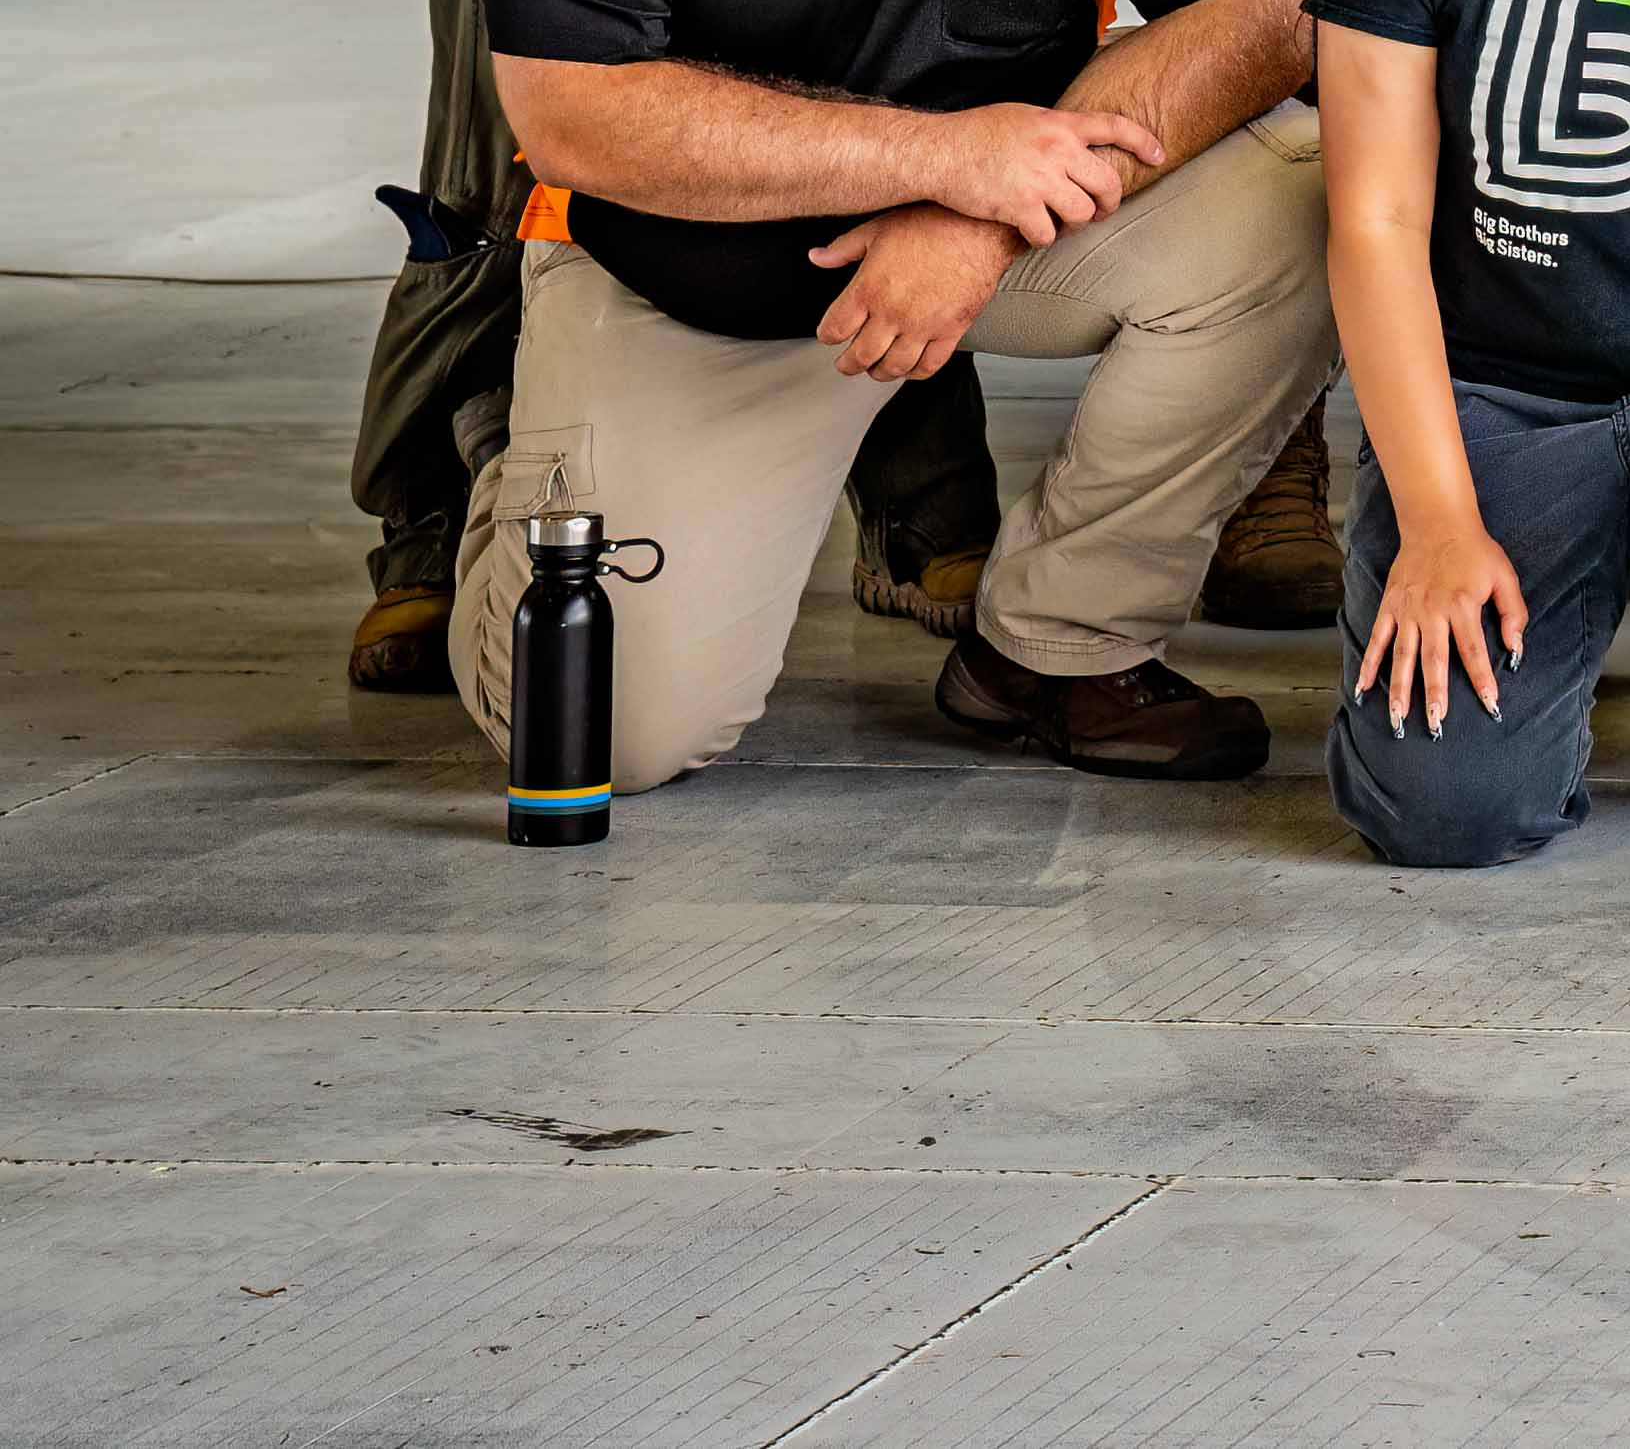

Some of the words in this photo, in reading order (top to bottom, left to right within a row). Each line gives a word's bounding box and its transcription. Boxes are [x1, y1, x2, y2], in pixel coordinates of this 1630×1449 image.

[1473, 206, 1497, 235] Big
[1498, 216, 1569, 246] Brothers
[1475, 226, 1496, 255] Big
[1496, 237, 1559, 268] Sisters.
